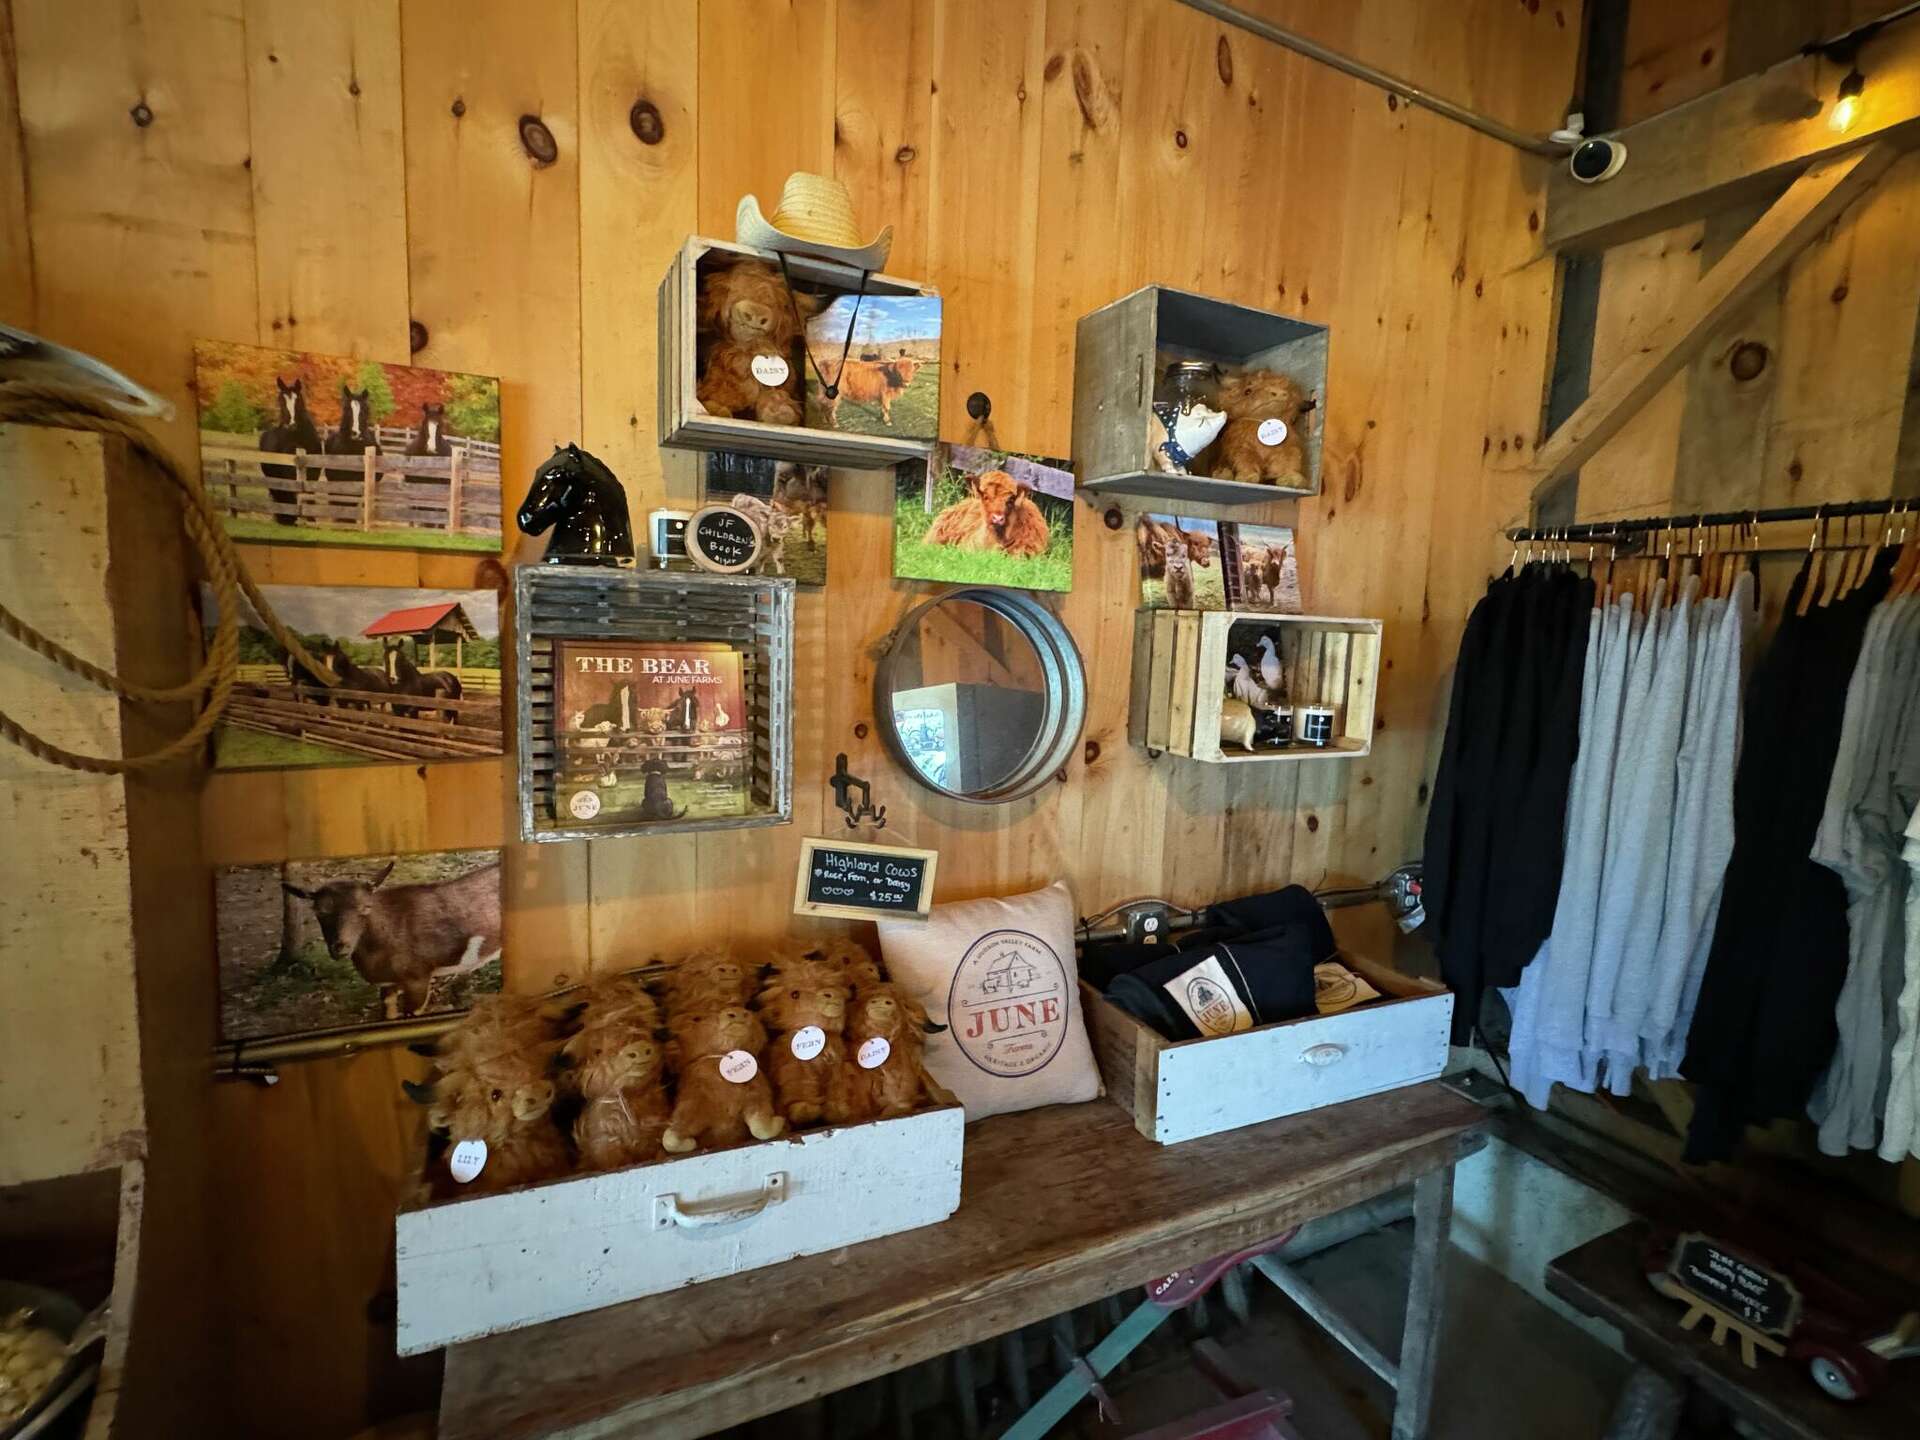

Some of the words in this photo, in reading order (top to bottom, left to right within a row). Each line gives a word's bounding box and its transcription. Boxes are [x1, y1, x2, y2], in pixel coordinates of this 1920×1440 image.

[718, 518, 735, 528] JF
[575, 656, 633, 673] THE
[640, 658, 711, 675] BEAR
[652, 675, 663, 684] AT
[666, 675, 690, 684] JUNE
[691, 676, 723, 685] FARMS
[825, 853, 880, 873] Highland
[884, 863, 918, 878] Cows
[1024, 942, 1042, 955] FARM
[966, 997, 1060, 1039] JUNE
[1202, 1000, 1230, 1023] JUNE
